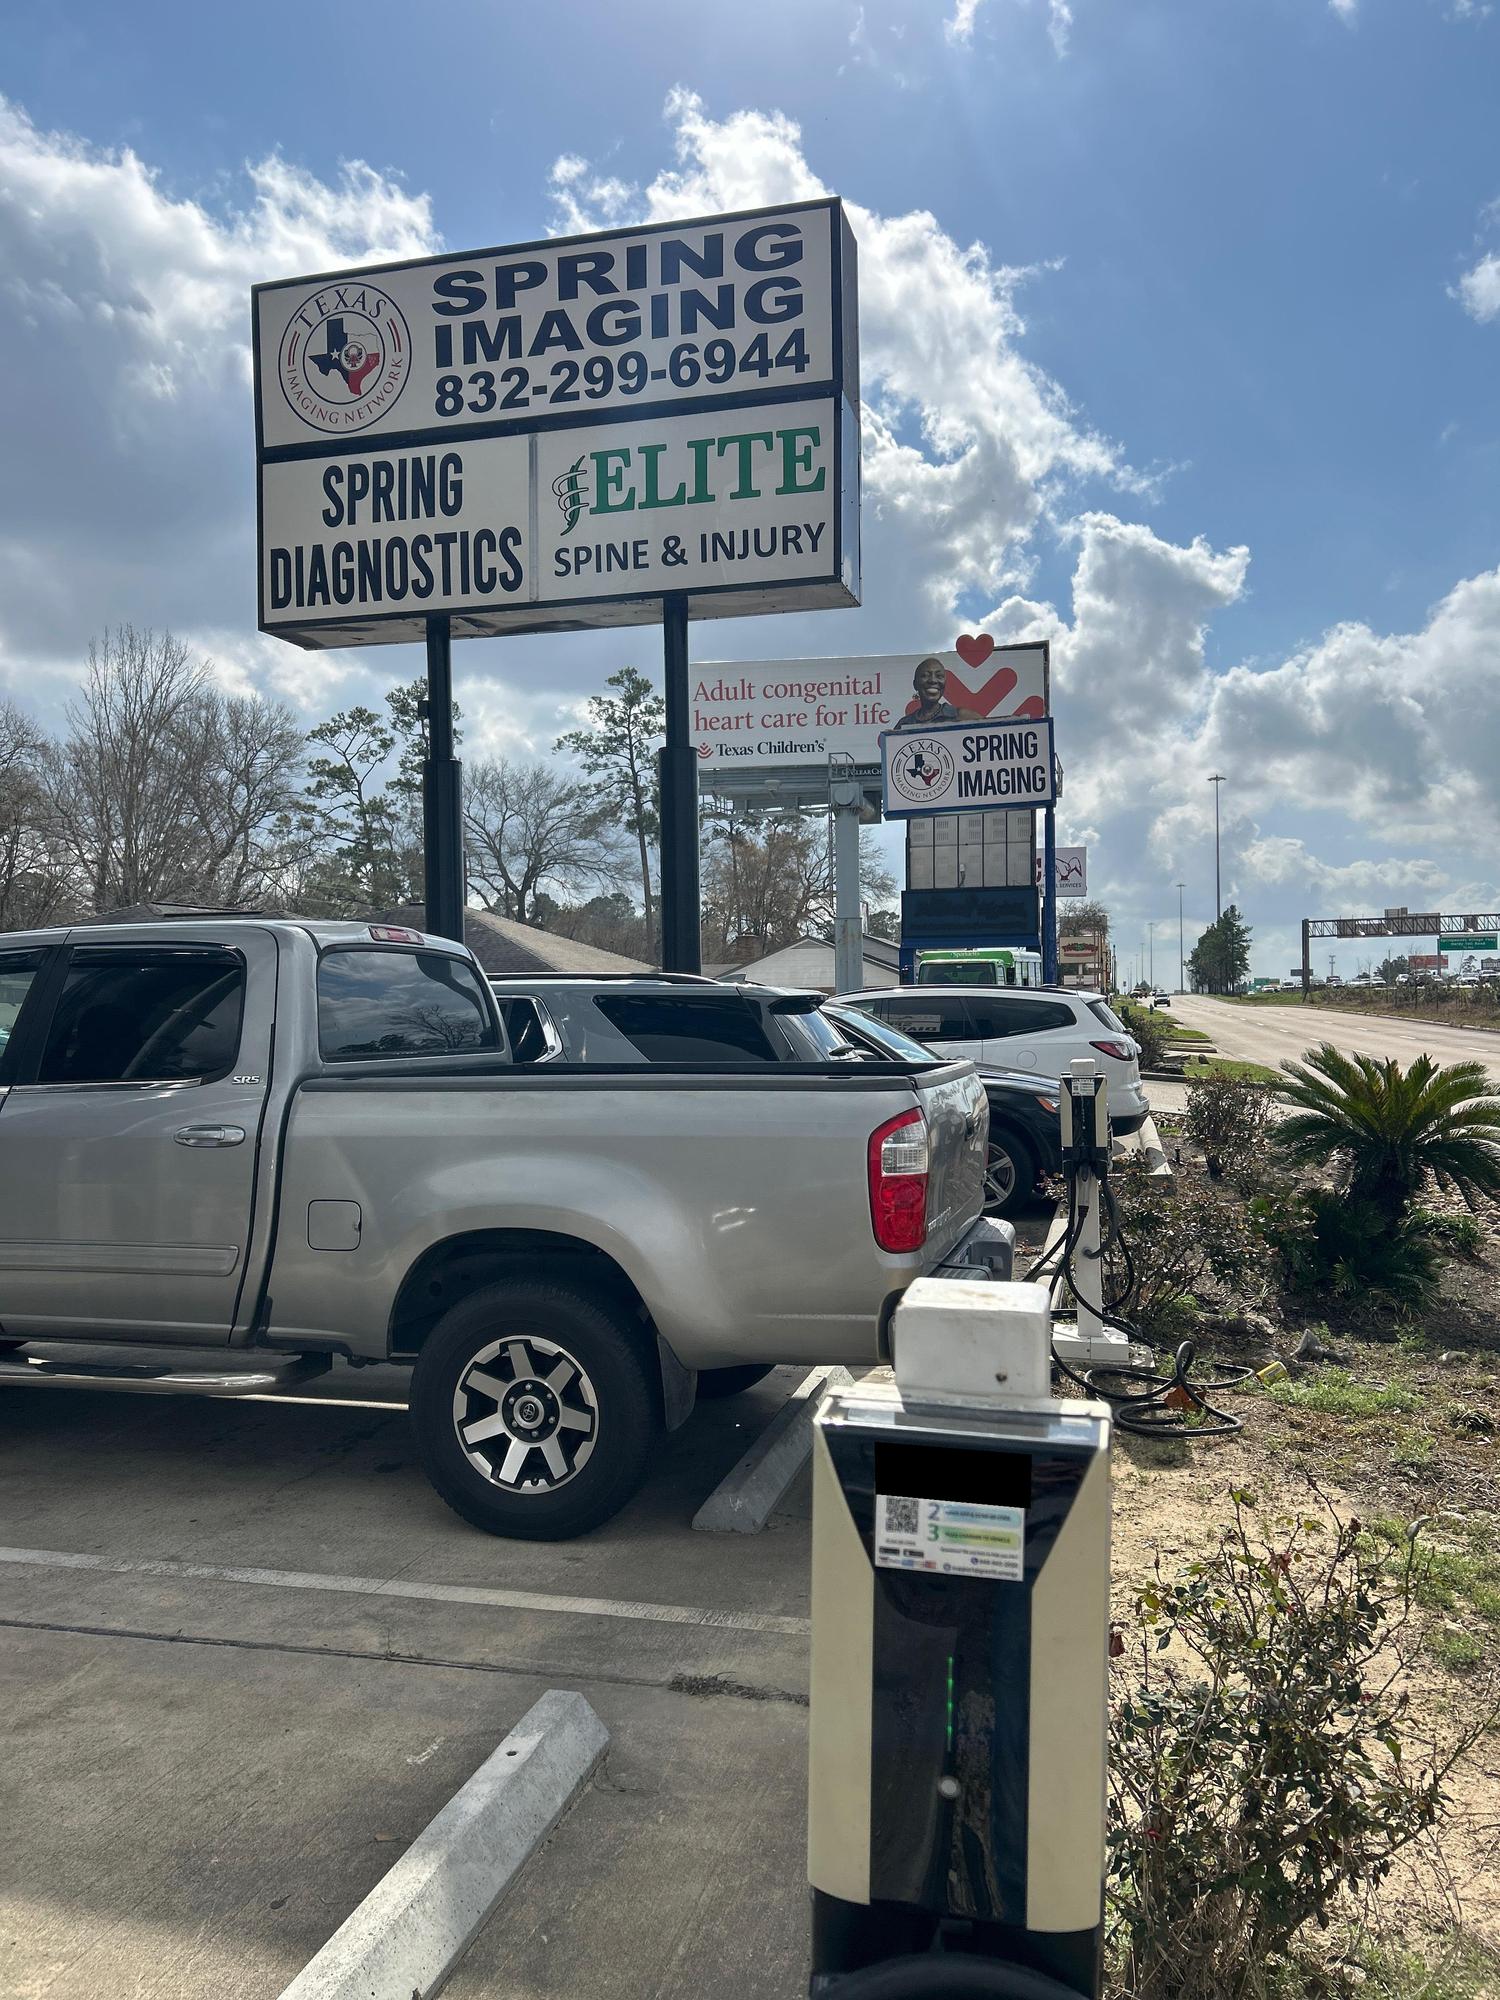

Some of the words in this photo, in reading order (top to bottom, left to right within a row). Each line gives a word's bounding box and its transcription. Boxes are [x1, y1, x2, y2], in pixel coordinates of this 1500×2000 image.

[432, 223, 804, 316] SPRING
[294, 288, 387, 329] TEXAS
[435, 276, 804, 368] IMAGING
[287, 368, 340, 424] IMAGING
[345, 358, 403, 424] NETWORK
[434, 328, 811, 417] 832-299-6944
[589, 426, 826, 515] ELITE
[322, 453, 463, 527] SPRING
[270, 526, 523, 610] DIAGNOSTICS
[554, 539, 649, 577] SPINE
[661, 535, 689, 566] &
[700, 522, 826, 564] INJURY
[694, 678, 756, 702] Adult
[762, 672, 882, 704] congenital
[694, 709, 754, 731] heart
[761, 711, 808, 728] care
[815, 704, 848, 727] for
[854, 702, 891, 725] life
[716, 743, 753, 757] Texas
[757, 739, 825, 755] Children's
[900, 741, 943, 758] TEXAS
[962, 731, 1038, 763] SPRING
[896, 774, 921, 798] IMAGING
[923, 769, 951, 798] NETWORK
[958, 765, 1046, 798] IMAGING
[928, 1502, 940, 1521] 2
[927, 1523, 939, 1541] 3
